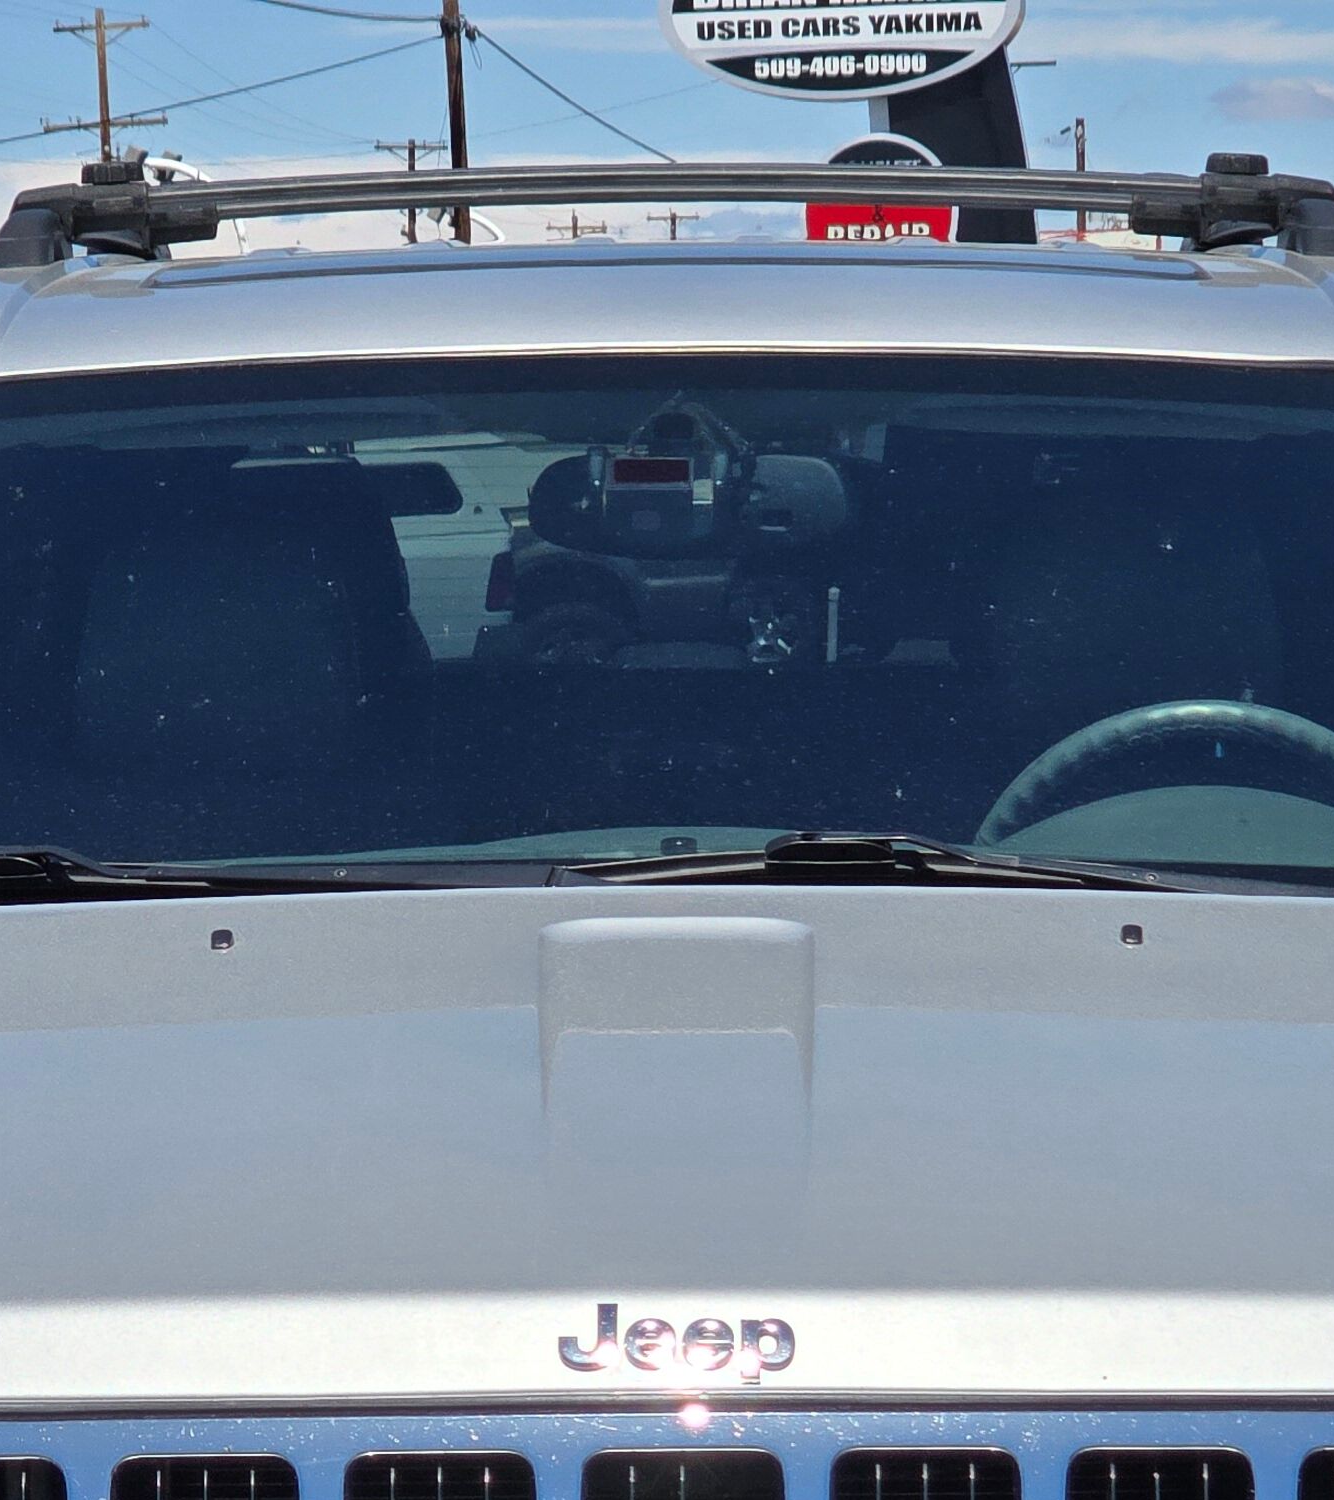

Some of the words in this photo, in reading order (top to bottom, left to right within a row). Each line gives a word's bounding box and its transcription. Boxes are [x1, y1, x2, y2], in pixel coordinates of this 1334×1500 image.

[696, 19, 772, 41] USED
[781, 15, 861, 39] CARS
[868, 11, 983, 35] YAKIMA
[754, 53, 928, 79] 509-406-0900
[558, 1303, 795, 1385] Jeep
